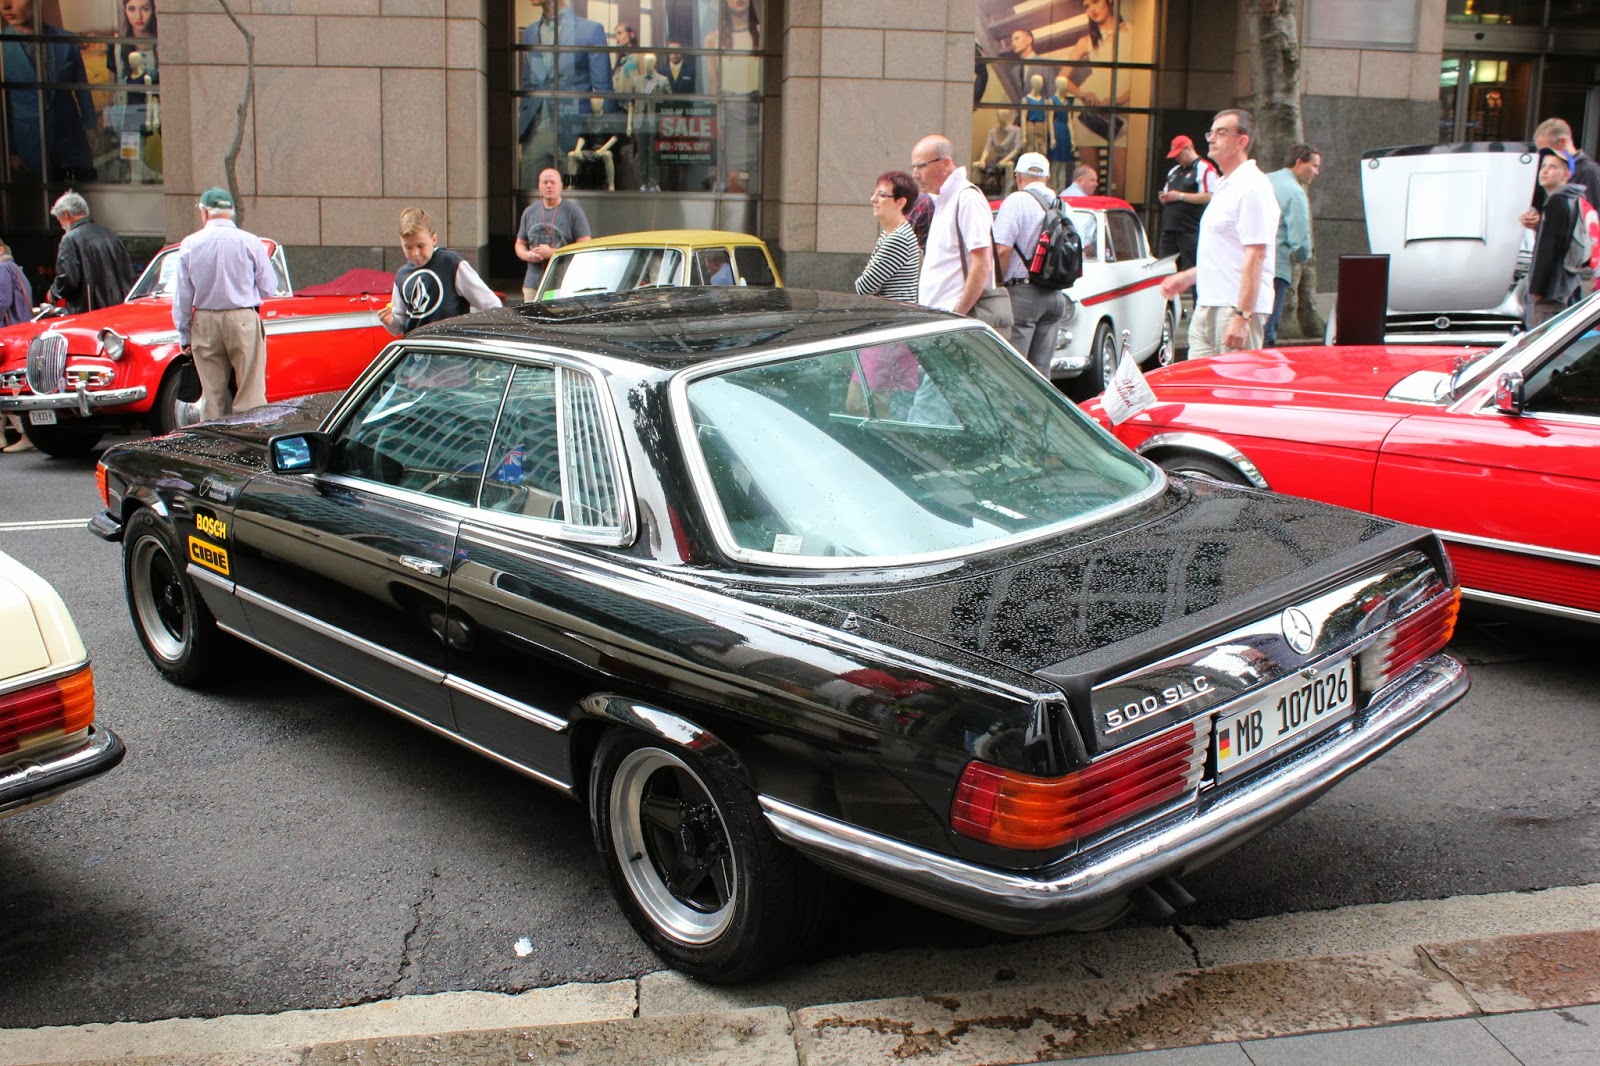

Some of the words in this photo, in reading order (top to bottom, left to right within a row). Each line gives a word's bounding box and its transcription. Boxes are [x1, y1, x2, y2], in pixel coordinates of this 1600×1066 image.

[662, 118, 712, 137] SALE
[1122, 379, 1135, 395] The
[196, 513, 227, 540] BOSCH
[1105, 695, 1159, 728] 500
[1161, 675, 1210, 704] SLC
[1236, 709, 1264, 757] MB
[1277, 667, 1349, 736] 107026
